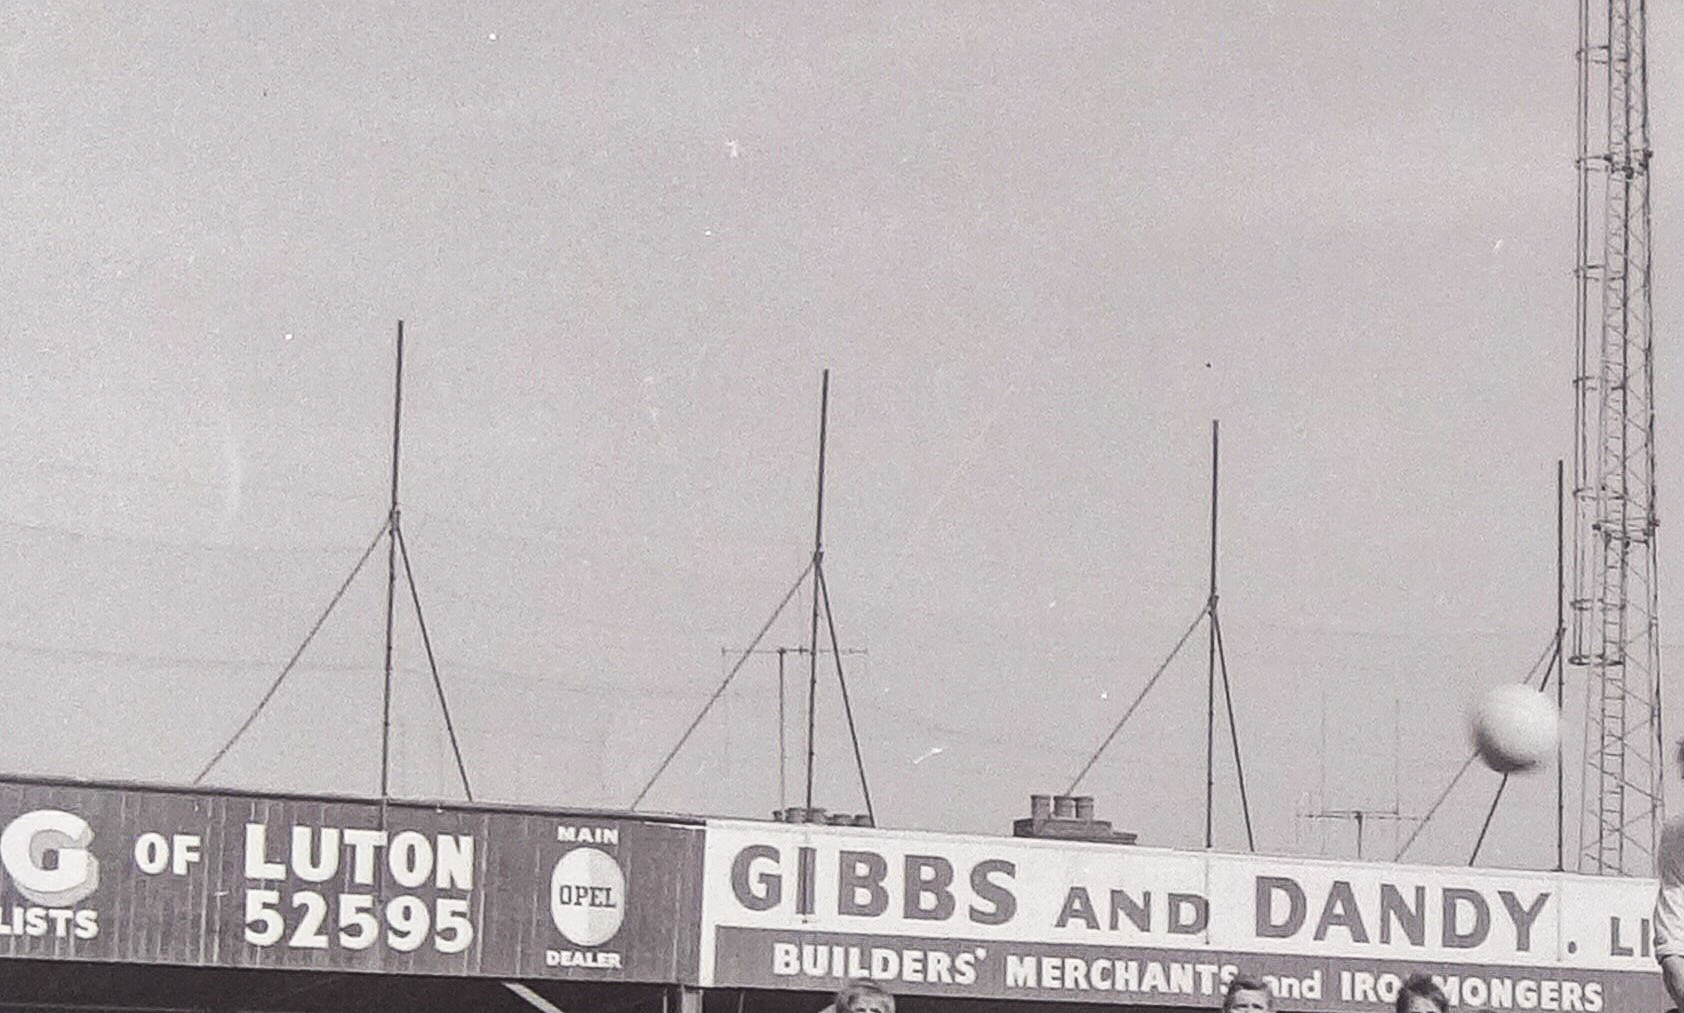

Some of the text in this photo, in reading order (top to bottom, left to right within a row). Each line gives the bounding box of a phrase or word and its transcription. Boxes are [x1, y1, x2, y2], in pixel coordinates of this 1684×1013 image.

[134, 834, 201, 877] OF
[245, 824, 473, 890] LUTON
[557, 826, 619, 845] MAIN
[558, 884, 620, 910] OPEL
[731, 844, 1017, 925] GIBBS
[1055, 885, 1211, 936] AND
[244, 890, 474, 953] 52595
[546, 949, 624, 969] DEALER
[1005, 954, 1238, 996] MERCHANTS
[1341, 970, 1603, 1013] IROMONGERS
